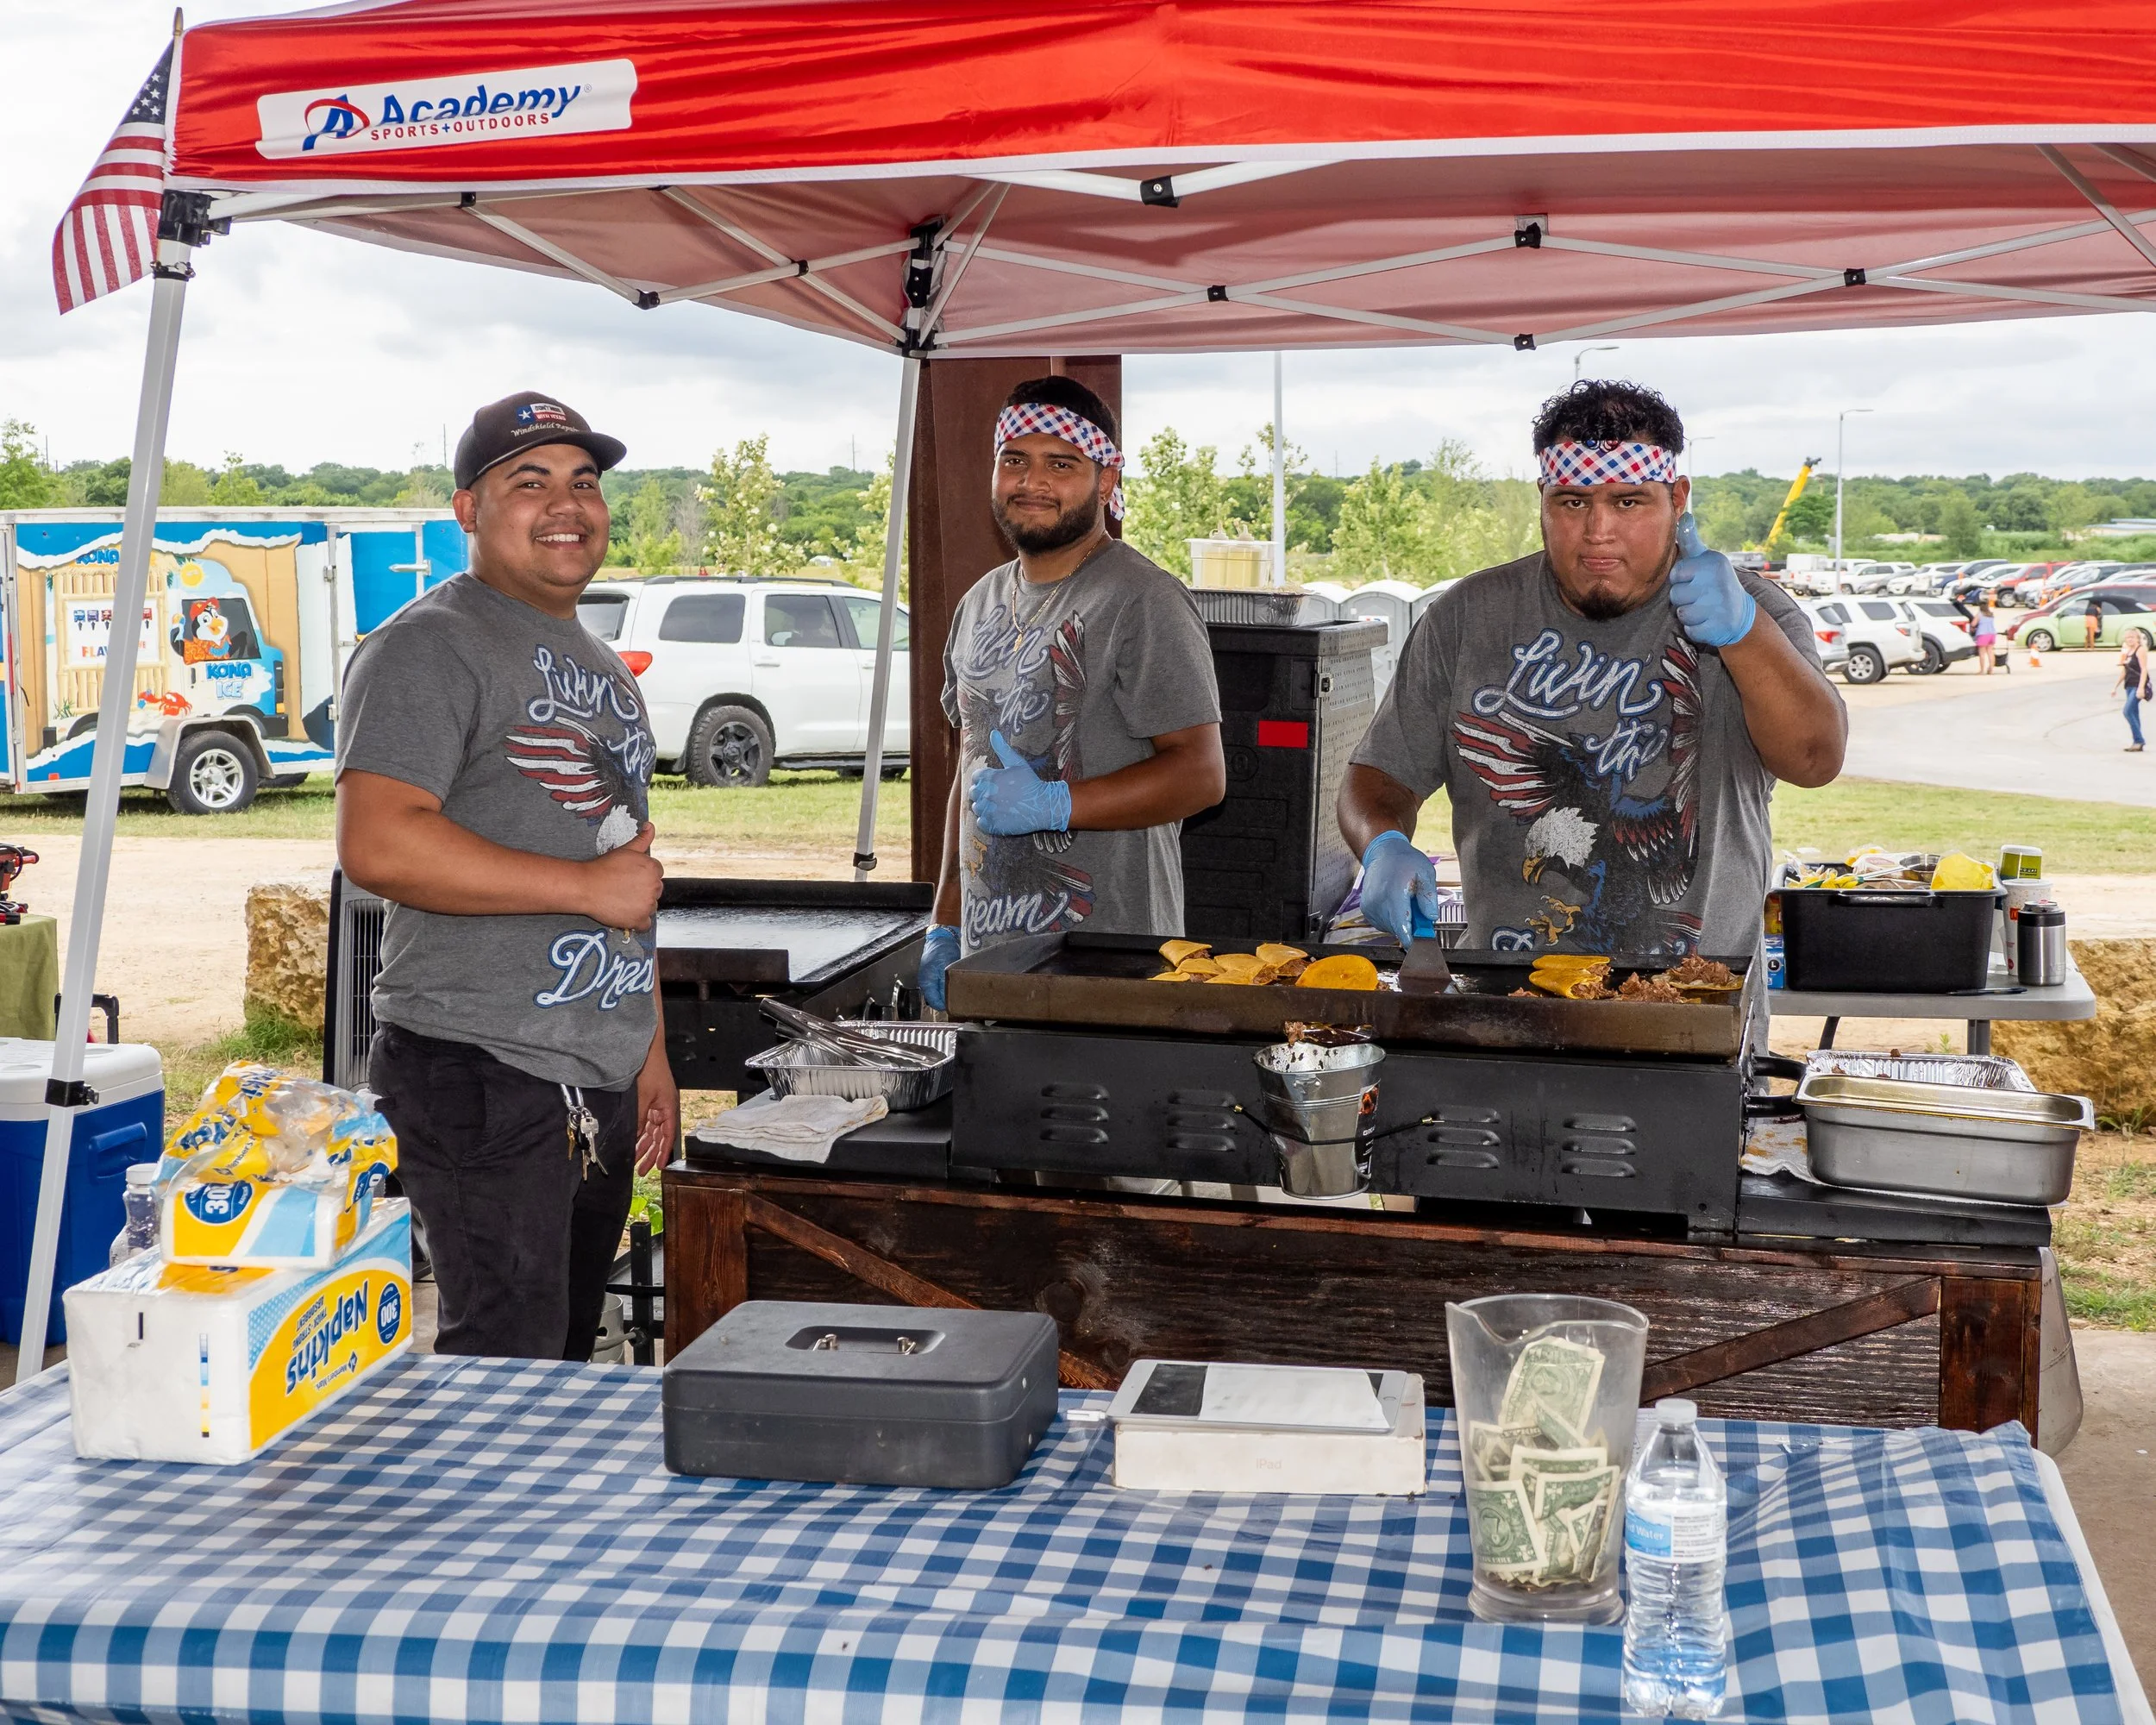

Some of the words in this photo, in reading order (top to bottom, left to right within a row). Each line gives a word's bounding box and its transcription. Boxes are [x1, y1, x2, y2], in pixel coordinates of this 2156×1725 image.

[379, 84, 581, 126] Academy
[511, 422, 555, 437] Windshield
[205, 662, 253, 680] KONA
[216, 681, 243, 699] ICE
[993, 675, 1050, 735] the
[962, 889, 1071, 949] ream
[532, 927, 655, 1012] Drea
[380, 1298, 398, 1327] 300
[285, 1279, 369, 1396] Napkins
[1256, 1456, 1282, 1469] iPad
[1635, 1523, 1664, 1540] Water
